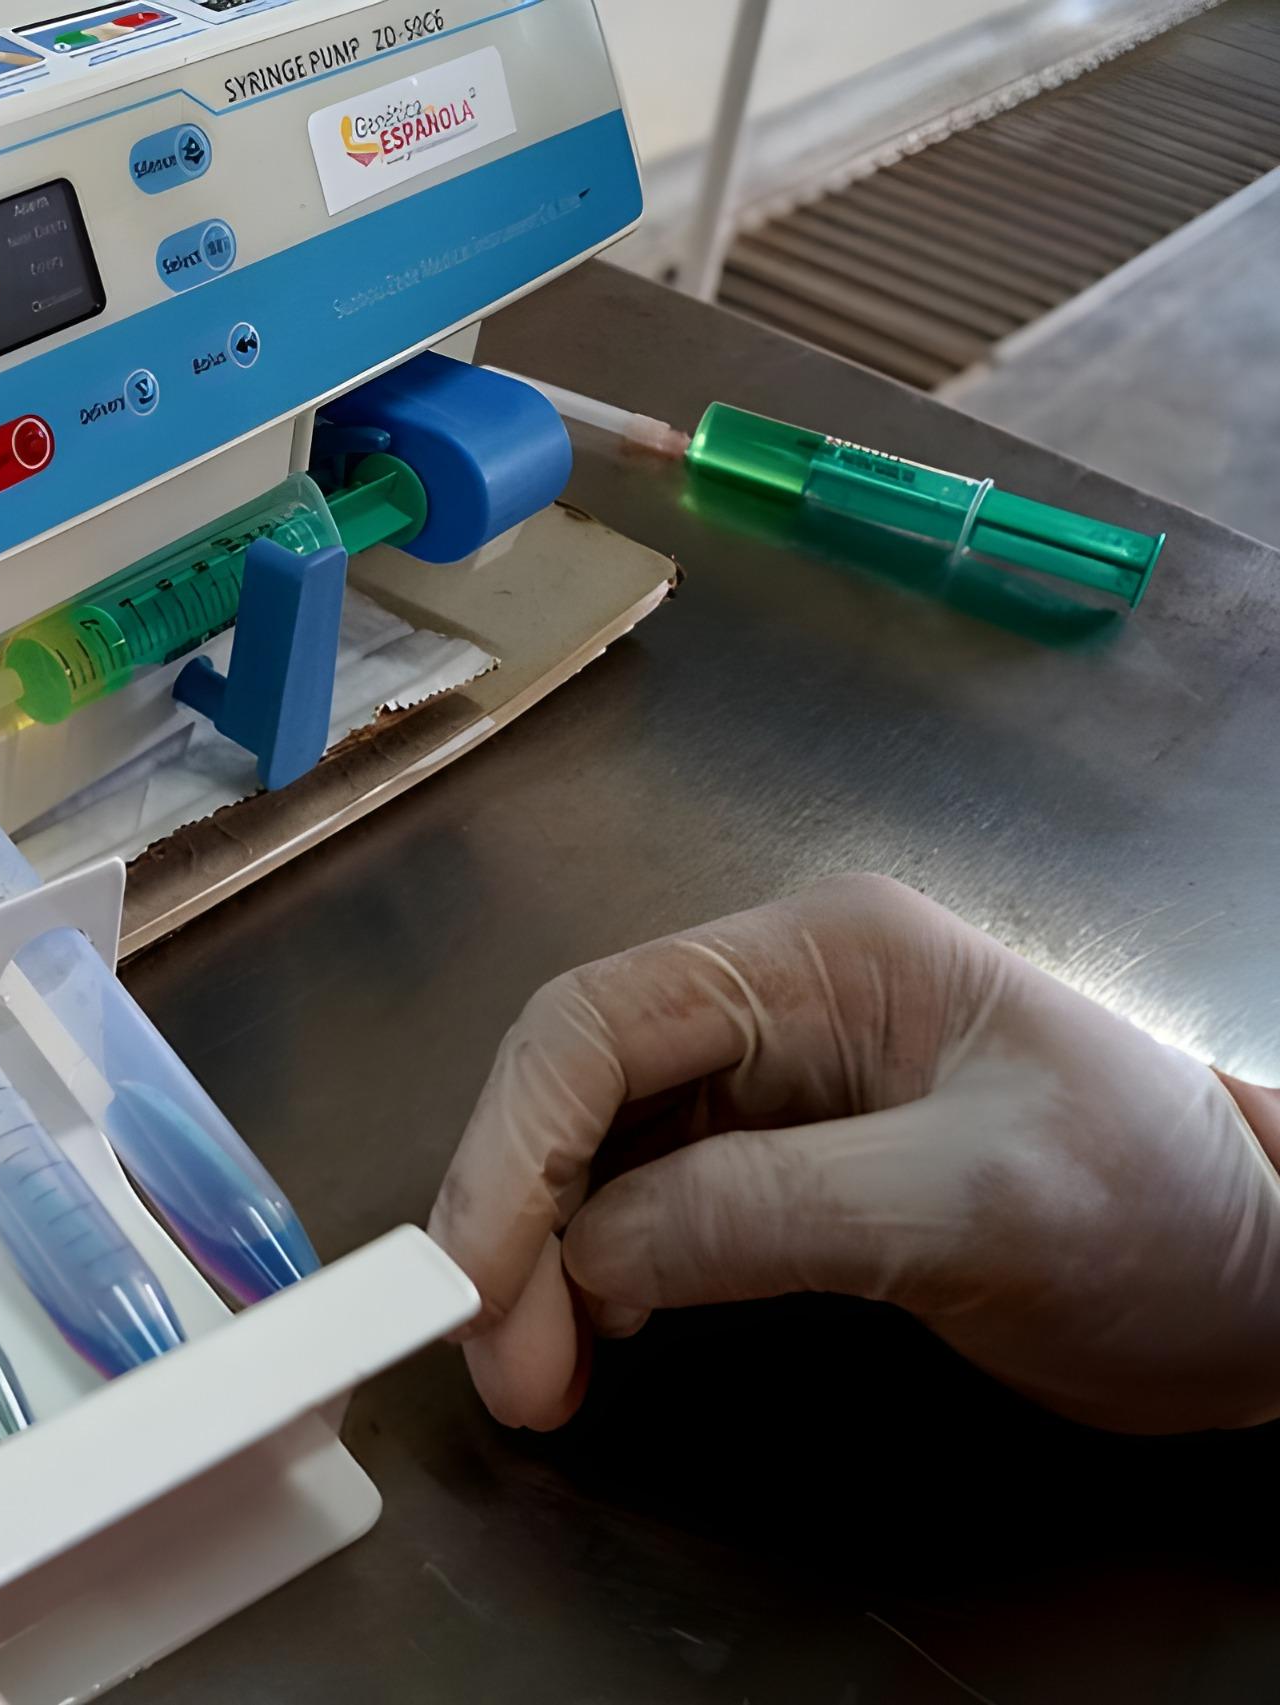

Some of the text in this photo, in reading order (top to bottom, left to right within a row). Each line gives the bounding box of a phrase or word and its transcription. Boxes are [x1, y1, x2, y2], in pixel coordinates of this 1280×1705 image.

[224, 54, 308, 103] SYRINGE
[309, 36, 361, 74] PUMP
[380, 99, 476, 155] ESPAÑOLA
